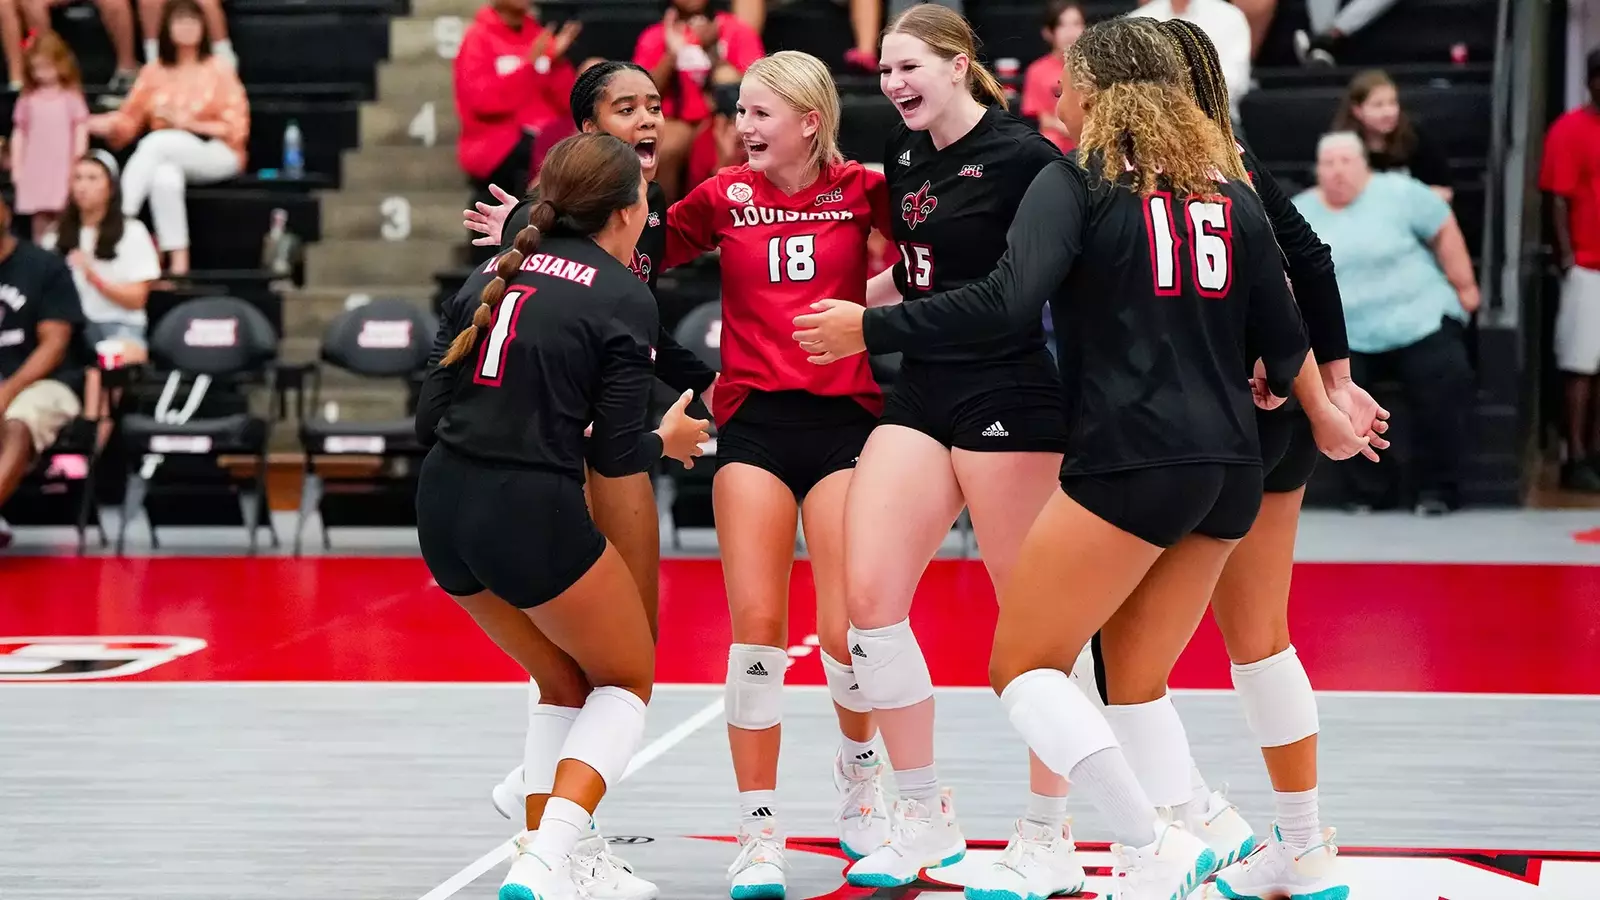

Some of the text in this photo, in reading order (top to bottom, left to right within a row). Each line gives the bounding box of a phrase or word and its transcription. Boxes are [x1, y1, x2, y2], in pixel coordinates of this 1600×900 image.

[408, 101, 437, 148] 4
[380, 196, 411, 240] 3
[768, 234, 817, 283] 18
[899, 243, 933, 289] 15
[1143, 191, 1231, 297] 16
[482, 253, 598, 287] LISIANA
[475, 286, 534, 385] 1
